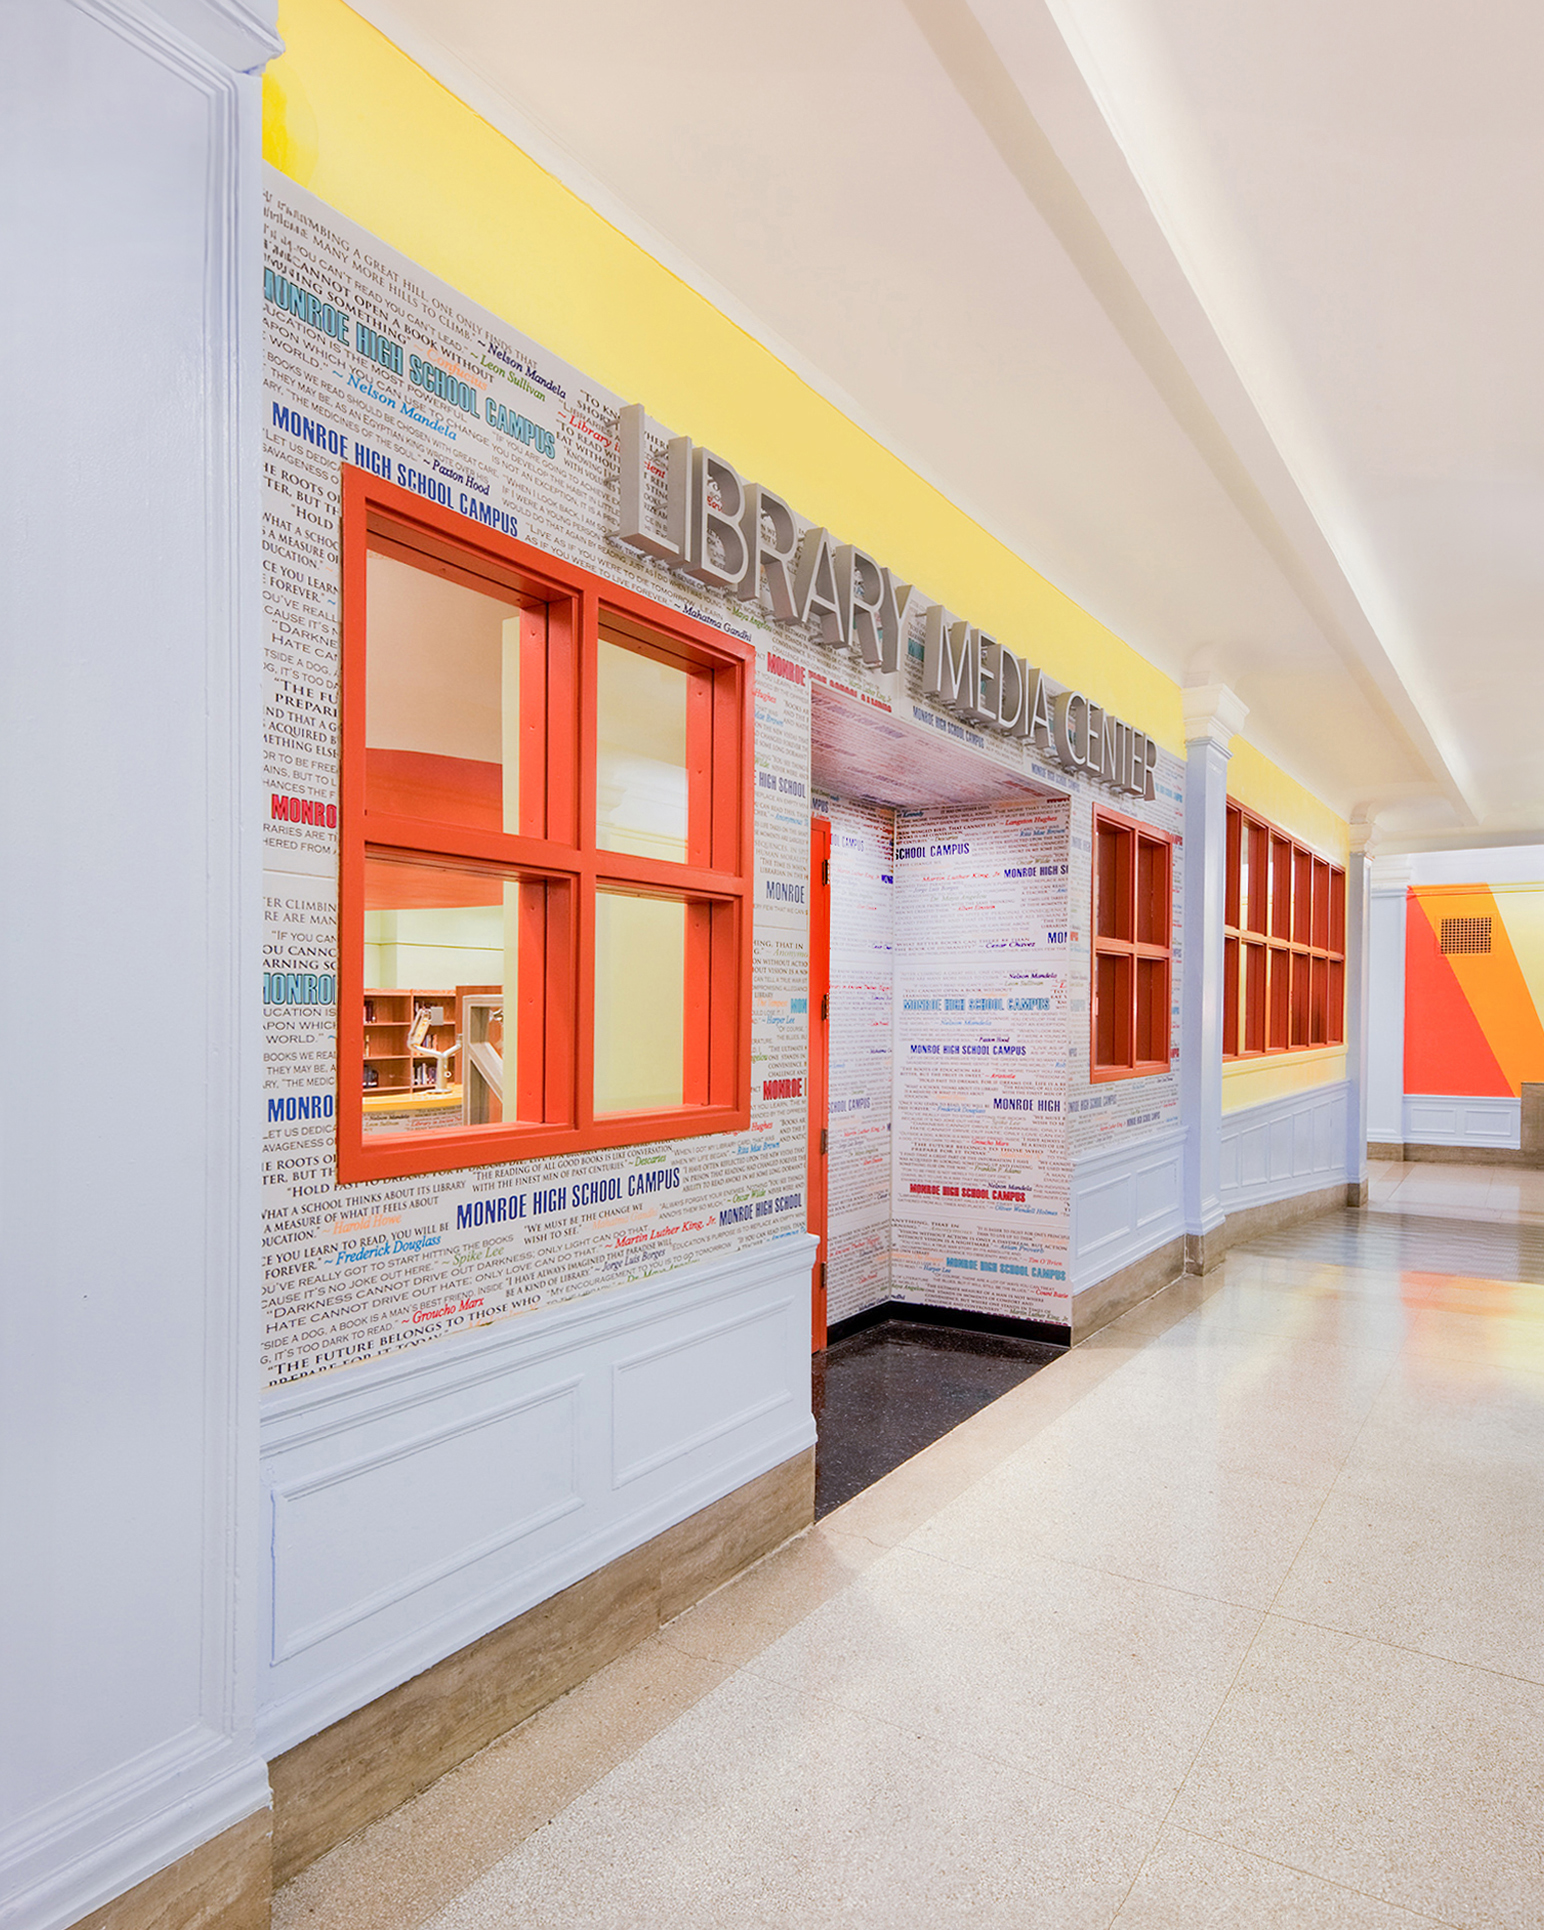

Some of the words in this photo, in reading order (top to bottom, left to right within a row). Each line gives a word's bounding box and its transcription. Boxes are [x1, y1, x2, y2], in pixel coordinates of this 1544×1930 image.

[312, 234, 349, 264] MANY
[351, 259, 385, 288] MORE
[388, 281, 418, 308] HILLS
[420, 301, 436, 318] TO
[317, 258, 352, 284] CAN'T
[353, 279, 383, 304] READ
[383, 297, 405, 317] YOU
[405, 312, 436, 336] CAN'T
[352, 247, 361, 260] A
[362, 253, 399, 283] GREAT
[430, 297, 454, 318] ONE
[455, 312, 483, 335] ONLY
[484, 329, 513, 355] FINDS
[513, 348, 538, 369] THAT
[353, 293, 389, 321] OPEN
[391, 317, 401, 329] A
[403, 322, 438, 352] BOOK
[439, 344, 494, 383] WITHOUT
[424, 342, 488, 391] Confucius
[479, 352, 506, 378] Leon
[506, 369, 546, 402] Sullivan
[486, 340, 523, 373] Nelson
[523, 361, 566, 399] Mandela
[301, 338, 346, 370] WHICH
[347, 363, 374, 387] YOU
[375, 379, 401, 400] CAN
[402, 393, 426, 414] USE
[427, 406, 444, 422] TO
[444, 417, 490, 447] CHANGE
[346, 372, 396, 409] Nelson
[397, 397, 457, 441] Mandela
[355, 320, 404, 377] HIGH
[407, 352, 481, 420] SCHOOL
[484, 396, 556, 460] CAMPUS
[568, 413, 612, 452] Library
[271, 400, 348, 461] MONROE
[354, 441, 391, 480] HIGH
[396, 462, 454, 509] SCHOOL
[457, 491, 518, 537] CAMPUS
[431, 457, 464, 484] Paxton
[464, 473, 490, 496] Hood
[262, 538, 323, 570] DUCATION."
[619, 404, 915, 673] LIBRARY
[923, 605, 1051, 748] MEDIA
[1053, 691, 1158, 800] CENTER
[766, 650, 806, 687] MONROE
[935, 715, 947, 732] HIGH
[947, 721, 965, 741] SCHOOL
[965, 730, 985, 749] CAMPUS
[758, 770, 777, 791] HIGH
[777, 776, 806, 799] SCHOOL
[270, 792, 337, 829] MONRO
[930, 843, 970, 857] CAMPUS
[1004, 866, 1037, 878] MONROE
[1039, 865, 1059, 876] HIGH
[765, 879, 805, 904] MONROE
[262, 971, 338, 1007] ONRO
[944, 998, 965, 1011] HIGH
[968, 998, 1004, 1011] SCHOOL
[1007, 997, 1051, 1011] CAMPUS
[765, 1014, 786, 1025] Harper
[784, 1014, 795, 1024] Lee
[910, 1044, 941, 1055] MONROE
[943, 1045, 960, 1055] HIGH
[961, 1045, 990, 1056] SCHOOL
[992, 1045, 1027, 1056] CAMPUS
[762, 1076, 803, 1101] MONROE
[993, 1098, 1034, 1112] MONROE
[1037, 1100, 1061, 1113] HIGH
[267, 1093, 333, 1123] MONRO
[750, 1119, 773, 1133] Hughes
[290, 1205, 299, 1216] A
[300, 1198, 343, 1215] SCHOOL
[344, 1191, 382, 1207] THINKS
[382, 1186, 415, 1201] ABOUT
[416, 1184, 431, 1196] ITS
[432, 1179, 466, 1193] LIBRARY
[456, 1192, 527, 1230] MONROE
[532, 1186, 567, 1215] HIGH
[571, 1176, 623, 1208] SCHOOL
[627, 1166, 680, 1197] CAMPUS
[718, 1203, 754, 1227] MONROE
[754, 1198, 773, 1218] HIGH
[773, 1192, 802, 1213] SCHOOL
[909, 1183, 941, 1195] MONROE
[942, 1185, 960, 1197] HIGH
[961, 1187, 990, 1200] SCHOOL
[991, 1190, 1026, 1203] CAMPUS
[331, 1214, 372, 1235] Harold
[370, 1210, 402, 1228] Howe
[612, 1229, 648, 1249] Martin
[648, 1224, 681, 1240] Luther
[334, 1241, 391, 1266] Frederick
[391, 1234, 441, 1254] Douglass
[451, 1248, 483, 1268] Spike
[484, 1245, 505, 1259] Lee
[598, 1259, 623, 1273] Jorge
[623, 1253, 640, 1266] Luis
[640, 1247, 666, 1262] Borges
[412, 1269, 448, 1286] DRIVE
[449, 1263, 474, 1277] OUT
[946, 1257, 978, 1271] MONROE
[980, 1259, 998, 1273] HIGH
[999, 1263, 1030, 1277] SCHOOL
[1031, 1266, 1067, 1281] CAMPUS
[411, 1303, 456, 1324] Groucho
[457, 1296, 485, 1312] Marx
[315, 1338, 374, 1364] FUTURE
[379, 1320, 442, 1347] BELONGS
[445, 1315, 464, 1328] TO
[467, 1302, 507, 1321] THOSE
[509, 1293, 541, 1312] WHO
